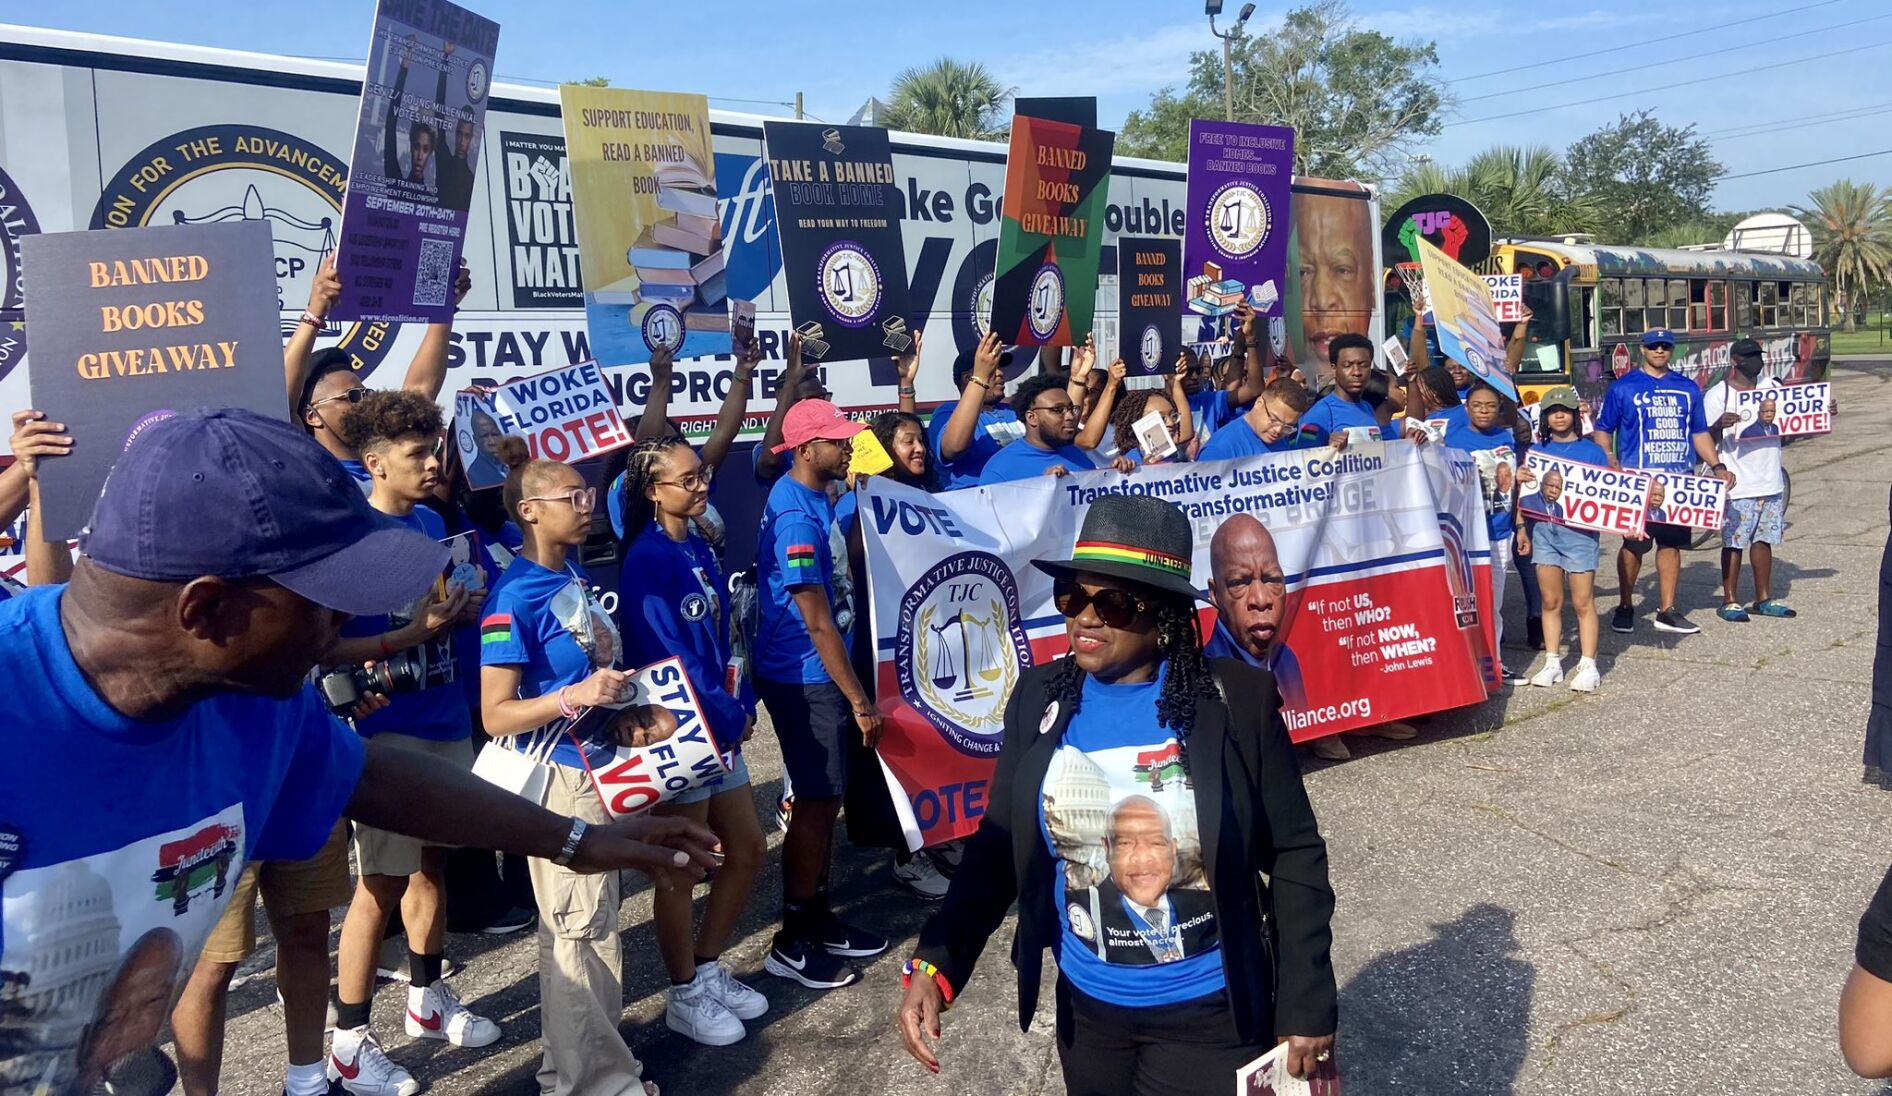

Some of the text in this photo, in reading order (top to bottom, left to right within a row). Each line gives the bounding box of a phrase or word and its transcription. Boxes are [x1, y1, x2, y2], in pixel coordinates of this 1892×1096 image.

[393, 106, 453, 130] VOTES MATTER
[582, 108, 695, 134] SUPPORT EDUCATION,
[602, 142, 685, 163] READ A BANNED
[1199, 132, 1287, 151] FREE TO INCLUSIVE
[129, 156, 174, 193] FOR
[175, 136, 223, 162] THE
[235, 135, 347, 193] ADVANCEM
[1037, 145, 1087, 172] BANNED
[1206, 159, 1277, 175] BANNED BOOKS
[770, 159, 894, 184] TAKE A BANNED
[397, 180, 425, 191] TRAINING
[632, 176, 663, 195] BOOK
[789, 182, 884, 206] BOOK HOME
[1037, 180, 1080, 204] BOOKS
[365, 195, 415, 216] SEPTEMBER
[1104, 196, 1184, 236] ouble
[511, 200, 578, 245] VOT
[798, 218, 888, 228] READ YOUR WAY TO FREEDOM
[1022, 214, 1088, 239] GIVEAWAY
[1412, 210, 1451, 235] TJC
[514, 245, 586, 288] MAT
[1135, 252, 1166, 266] BANNED
[89, 255, 209, 289] BANNED
[1138, 273, 1165, 287] BOOKS
[1482, 276, 1520, 287] OKE
[532, 291, 585, 299] BlackVotersMat
[1130, 293, 1172, 307] GIVEAWAY
[101, 300, 205, 333] BOOKS
[77, 341, 238, 381] GIVEAWAY
[447, 331, 550, 369] STAY
[1614, 354, 1629, 369] STOP
[508, 364, 600, 405] WOKE
[1739, 384, 1828, 406] PROTECT
[499, 389, 610, 434] FLORIDA
[1651, 395, 1677, 407] GET IN
[1783, 400, 1823, 415] OUR
[681, 419, 717, 433] RIGHT
[1655, 418, 1679, 429] GOOD
[1778, 413, 1828, 434] VOTE!
[1067, 452, 1382, 508] Transformative Justice Coalition
[1527, 456, 1647, 492] STAY WOKE
[1625, 470, 1725, 495] OTECT
[1564, 480, 1642, 507] FLORIDA
[1673, 490, 1717, 509] OUR
[870, 495, 964, 538] VOTE
[1564, 494, 1642, 531] VOTE!
[1667, 504, 1721, 529] VOTE!
[948, 582, 984, 603] TJC
[1329, 598, 1352, 613] not
[1353, 592, 1373, 609] US,
[899, 557, 965, 699] TRANSFORMATIVE
[967, 557, 1009, 588] JUSTICE
[1322, 606, 1392, 632] then WHO?
[1356, 631, 1376, 647] not
[1378, 623, 1420, 643] NOW,
[1351, 637, 1437, 667] then WHEN?
[1379, 656, 1433, 673] -John Lewis
[650, 664, 708, 746] STAY
[1282, 697, 1372, 732] lliance.org
[926, 709, 963, 744] IGNITING
[962, 736, 994, 753] CHANGE
[648, 743, 695, 796] FLO
[909, 779, 989, 832] OTE
[1106, 926, 1131, 938] Your
[1133, 928, 1157, 936] vote
[1108, 937, 1144, 947] almost
